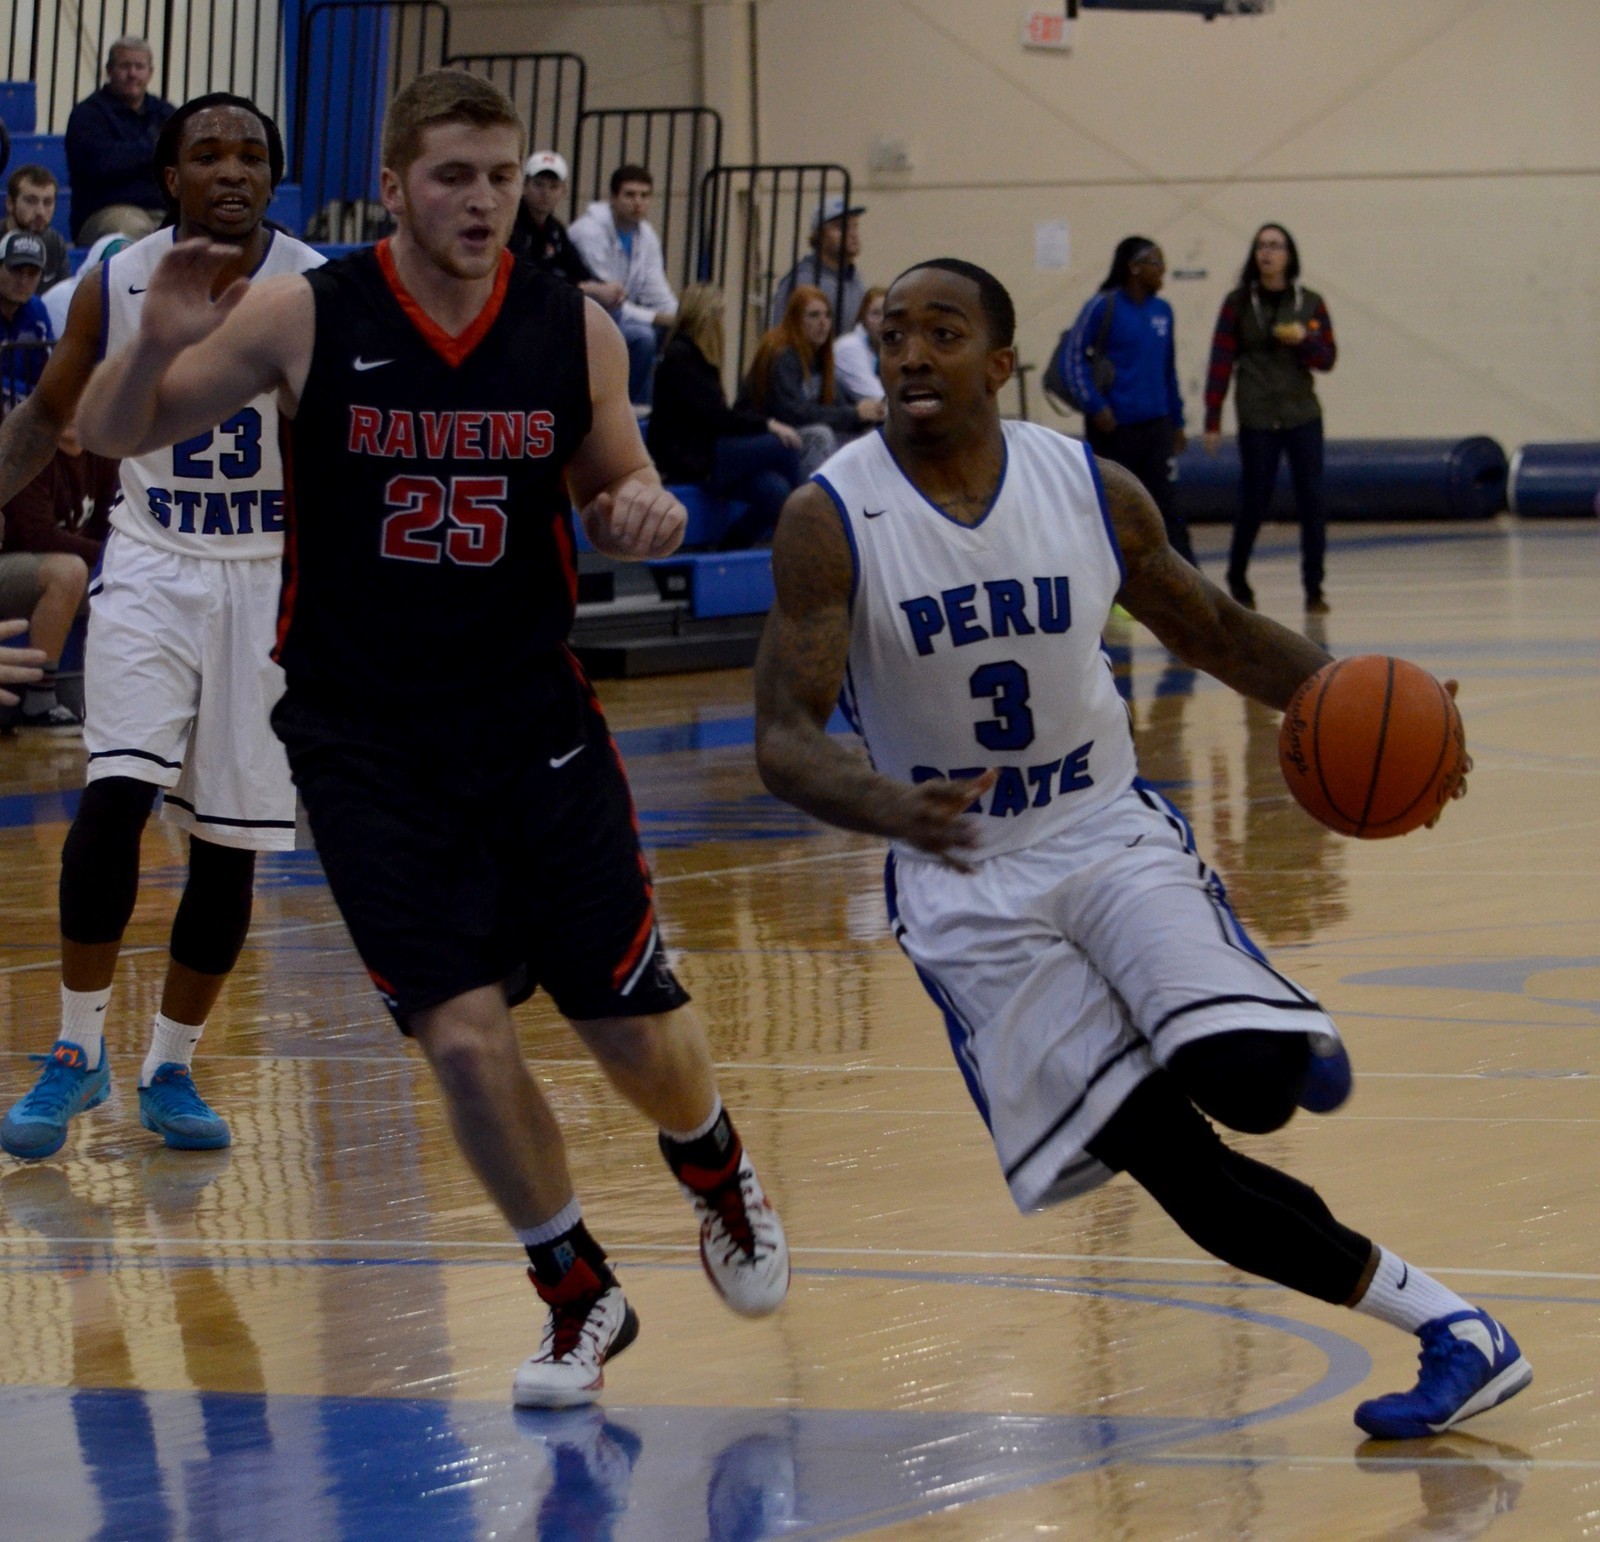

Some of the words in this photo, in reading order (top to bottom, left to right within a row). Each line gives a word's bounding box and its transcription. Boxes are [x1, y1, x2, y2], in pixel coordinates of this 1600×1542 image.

[173, 406, 262, 479] 23
[348, 404, 555, 460] RAVENS
[147, 487, 286, 535] STATE
[380, 474, 509, 567] 25
[899, 576, 1072, 656] PERU
[969, 660, 1035, 751] 3
